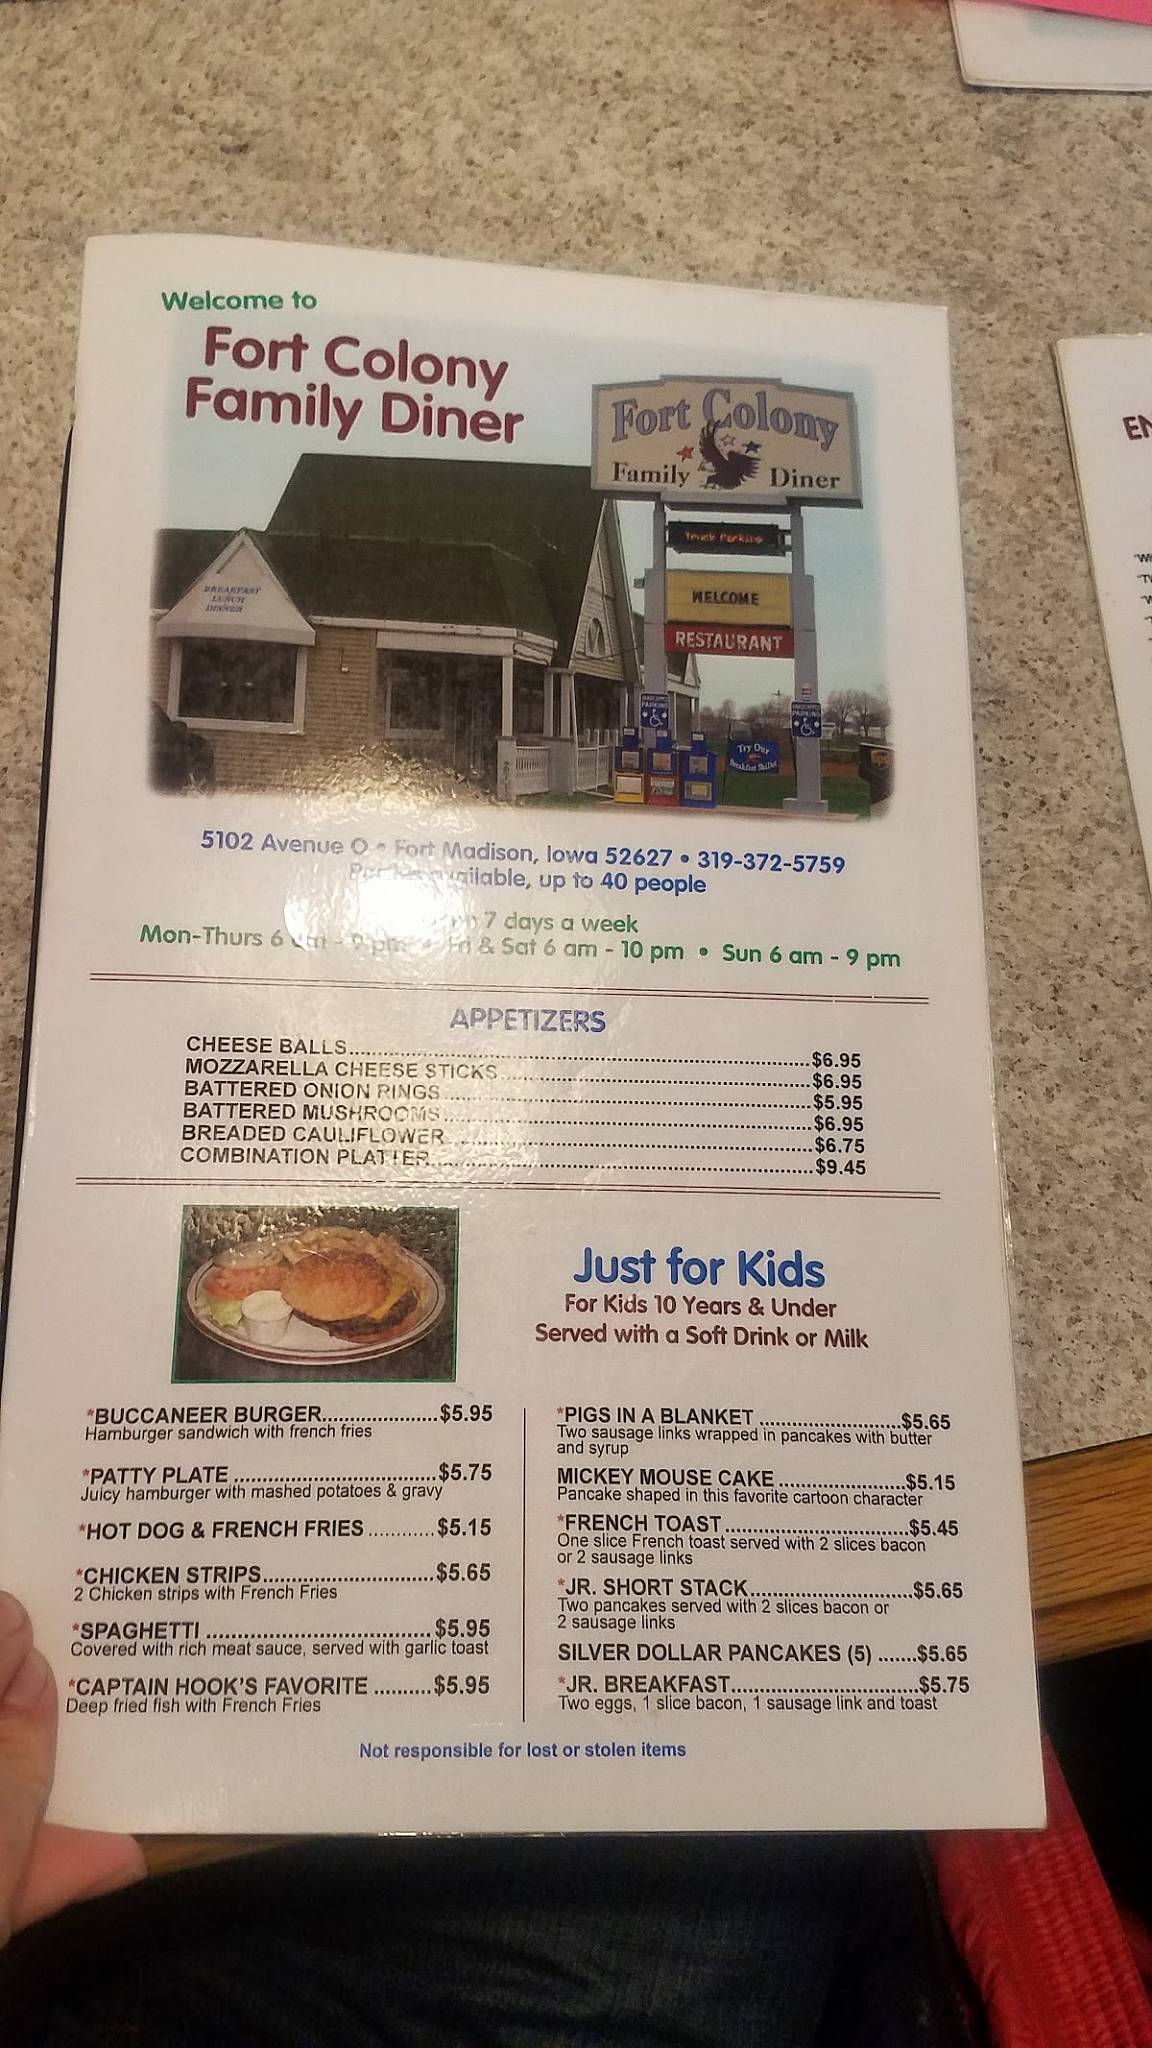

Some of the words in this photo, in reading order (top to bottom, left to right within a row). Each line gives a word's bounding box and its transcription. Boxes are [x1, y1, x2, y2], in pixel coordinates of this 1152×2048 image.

[161, 290, 284, 311] Welcome
[292, 290, 317, 310] to
[204, 326, 309, 373] Fort
[323, 336, 509, 401] Colony
[185, 376, 363, 441] Family
[381, 391, 524, 444] Diner
[611, 398, 692, 443] Fort
[702, 388, 839, 451] Colony
[612, 461, 690, 487] Family
[770, 466, 841, 489] Diner
[692, 590, 760, 606] WELCOME
[675, 630, 784, 652] RESTAURANT
[200, 830, 254, 851] 5102
[261, 833, 344, 855] Avenue
[350, 837, 369, 855] O
[395, 839, 435, 859] Fort
[442, 841, 539, 865] Madison,
[547, 846, 598, 864] Iowa
[604, 846, 673, 867] 52627
[698, 850, 845, 874] 319-372-5759
[539, 874, 566, 891] up
[573, 871, 593, 889] to
[600, 872, 627, 890] 40
[635, 874, 707, 896] people
[483, 912, 497, 929] 7
[505, 912, 553, 933] days
[561, 916, 574, 931] a
[581, 914, 638, 933] week
[139, 924, 262, 947] Mon-Thurs
[270, 930, 283, 947] 6
[501, 937, 537, 956] Sat
[543, 938, 556, 956] 6
[563, 942, 597, 957] am
[621, 940, 643, 958] 10
[650, 945, 684, 963] pm
[722, 944, 761, 963] Sun
[769, 946, 782, 964] 6
[789, 949, 823, 965] am
[846, 948, 859, 966] 9
[866, 952, 901, 971] pm
[449, 1006, 607, 1033] APPETIZERS
[186, 1036, 272, 1053] CHEESE
[279, 1038, 347, 1055] BALLS
[812, 1051, 862, 1070] $6.95
[185, 1058, 328, 1076] MOZZARELLA
[335, 1061, 418, 1077] CHEESE
[425, 1063, 497, 1079] STICKS
[812, 1072, 862, 1091] $6.95
[184, 1080, 297, 1098] BATTERED
[303, 1082, 370, 1099] ONION
[378, 1084, 441, 1100] RINGS
[813, 1093, 863, 1112] $5.95
[183, 1102, 295, 1120] BATTERED
[303, 1104, 441, 1122] MUSHROOMS
[814, 1115, 864, 1133] $6.95
[182, 1124, 286, 1142] BREADED
[293, 1126, 444, 1144] CAULIFLOWER
[815, 1136, 865, 1155] $6.75
[180, 1147, 330, 1164] COMBINATION
[337, 1149, 429, 1166] PLATTER
[816, 1158, 866, 1176] $9.45
[573, 1247, 656, 1284] Just
[666, 1246, 725, 1286] for
[738, 1249, 826, 1288] Kids
[565, 1293, 597, 1312] For
[604, 1294, 647, 1314] Kids
[656, 1295, 676, 1314] 10
[682, 1295, 741, 1316] Years
[748, 1298, 764, 1316] &
[771, 1298, 837, 1318] Under
[535, 1323, 606, 1343] Served
[615, 1324, 658, 1344] with
[666, 1329, 679, 1344] a
[686, 1325, 727, 1345] Soft
[734, 1326, 789, 1346] Drink
[795, 1332, 817, 1347] or
[825, 1328, 869, 1349] Milk
[234, 1406, 321, 1423] BURGER
[440, 1403, 493, 1423] $5.95
[617, 1407, 635, 1423] IN
[642, 1407, 655, 1424] A
[661, 1408, 753, 1425] BLANKET
[901, 1412, 951, 1431] $5.65
[85, 1426, 173, 1444] Hamburger
[178, 1425, 249, 1440] sandwich
[255, 1425, 284, 1439] with
[290, 1424, 335, 1438] french
[341, 1424, 372, 1438] fries
[162, 1466, 229, 1483] PLATE
[439, 1462, 492, 1483] $5.75
[557, 1468, 633, 1485] MICKEY
[640, 1469, 712, 1485] MOUSE
[718, 1470, 774, 1487] CAKE
[906, 1473, 955, 1492] $5.15
[138, 1522, 184, 1539] DOG
[191, 1522, 205, 1538] &
[212, 1520, 298, 1538] FRENCH
[305, 1520, 364, 1537] FRIES
[437, 1517, 491, 1538] $5.15
[654, 1515, 721, 1532] TOAST
[909, 1518, 959, 1537] $5.45
[187, 1566, 261, 1584] STRIPS
[436, 1562, 491, 1583] $5.65
[603, 1579, 674, 1596] SHORT
[680, 1579, 748, 1597] STACK
[913, 1581, 963, 1600] $5.65
[435, 1618, 490, 1639] $5.95
[558, 1643, 630, 1661] SILVER
[638, 1644, 721, 1661] DOLLAR
[729, 1644, 841, 1662] PANCAKES
[848, 1645, 872, 1666] (5)
[917, 1645, 968, 1663] $5.65
[265, 1677, 368, 1695] FAVORITE
[434, 1675, 490, 1696] $5.95
[604, 1676, 731, 1693] BREAKFAST
[919, 1675, 970, 1695] $5.75
[558, 1695, 589, 1710] Two
[595, 1698, 636, 1713] eggs,
[643, 1696, 649, 1709] 1
[657, 1695, 690, 1710] slice
[696, 1695, 746, 1712] bacon,
[753, 1695, 760, 1709] 1
[767, 1698, 832, 1713] sausage
[837, 1696, 862, 1710] link
[867, 1696, 895, 1710] and
[900, 1696, 938, 1710] toast
[359, 1743, 389, 1758] Not
[395, 1741, 492, 1761] responsible
[498, 1741, 521, 1757] for
[527, 1741, 558, 1757] lost
[562, 1745, 580, 1757] or
[584, 1742, 636, 1757] stolen
[641, 1741, 686, 1757] items
